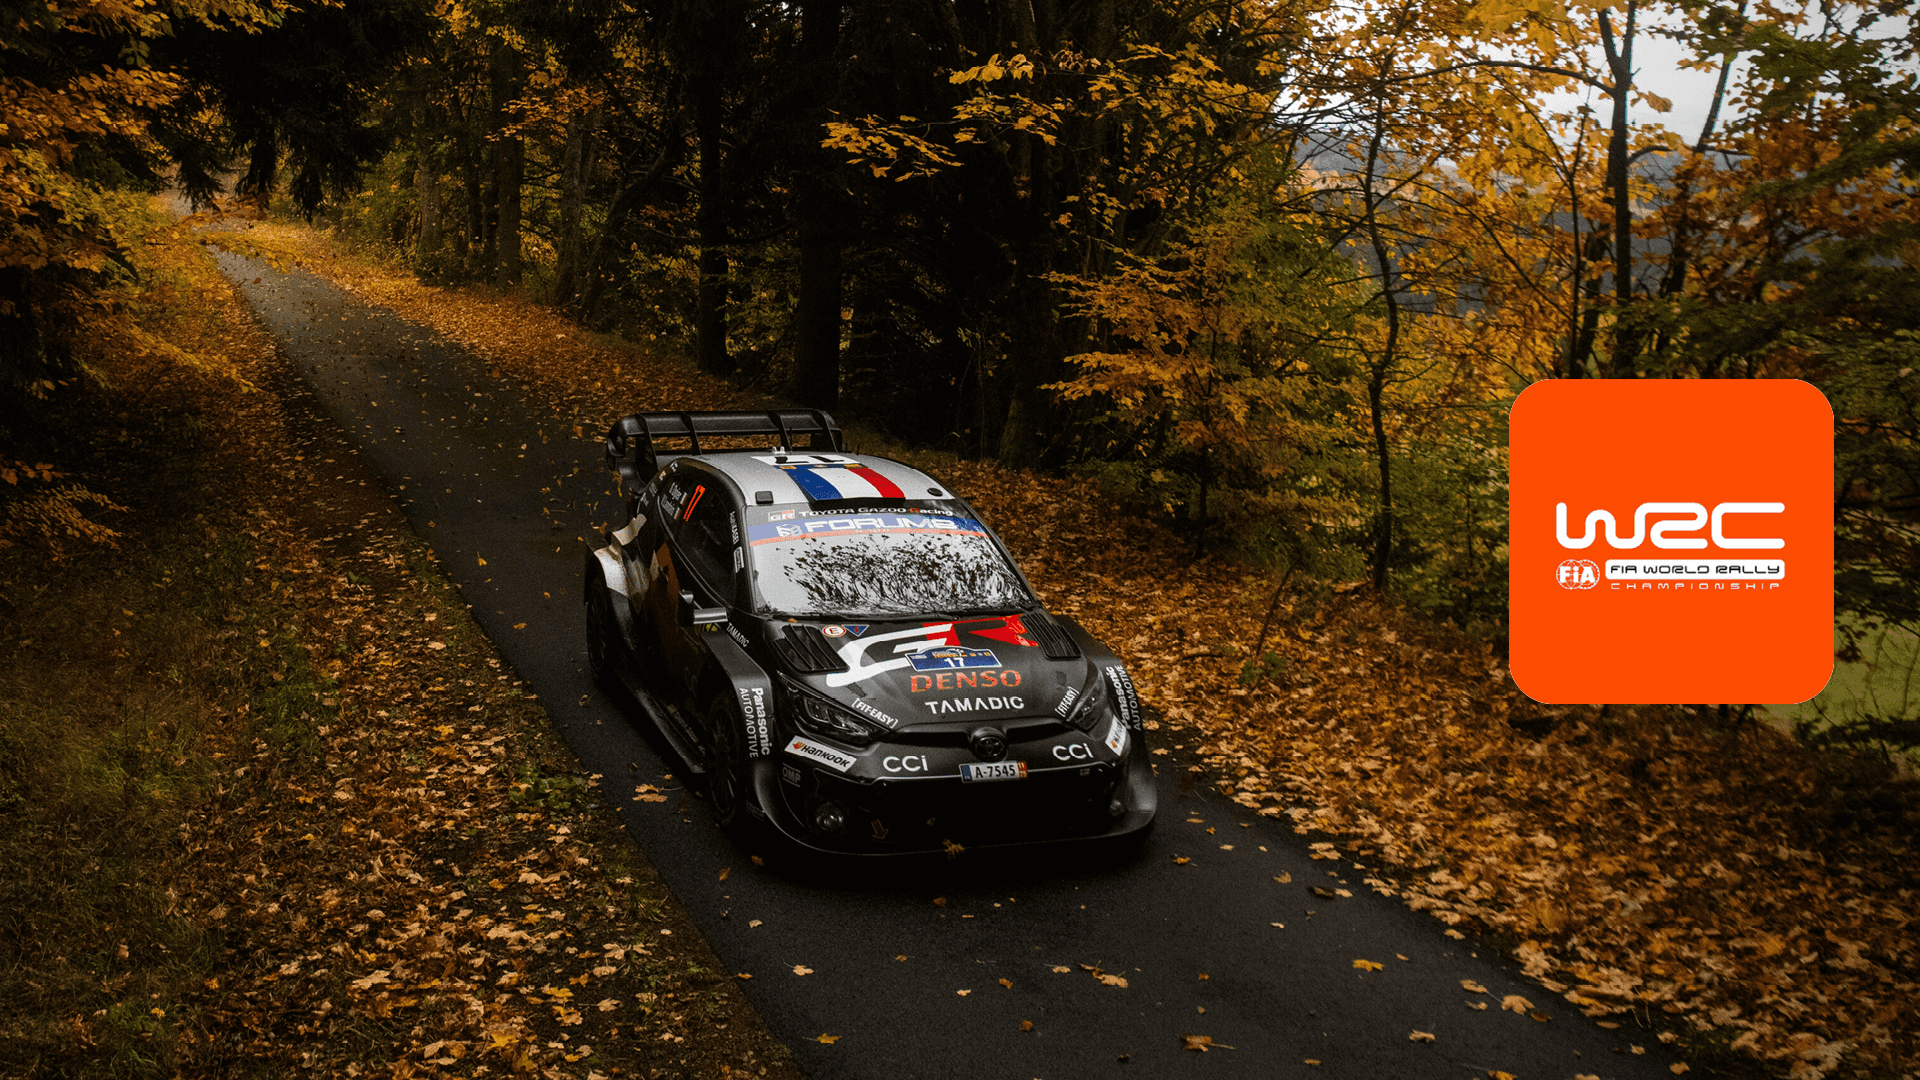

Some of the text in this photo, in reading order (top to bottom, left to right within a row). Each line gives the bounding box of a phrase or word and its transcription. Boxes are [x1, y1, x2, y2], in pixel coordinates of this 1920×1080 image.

[799, 508, 855, 516] TOYOTA
[726, 622, 750, 648] TAMADIC
[944, 657, 965, 667] 17
[910, 670, 1022, 692] DENSO
[924, 696, 1025, 714] TAMADIC
[1105, 666, 1132, 730] Panasonic
[1114, 664, 1142, 731] AUTOMOTIVE
[739, 687, 759, 758] AUTOMOTIVE
[751, 687, 772, 756] Panasonic
[975, 764, 1016, 779] A-7545
